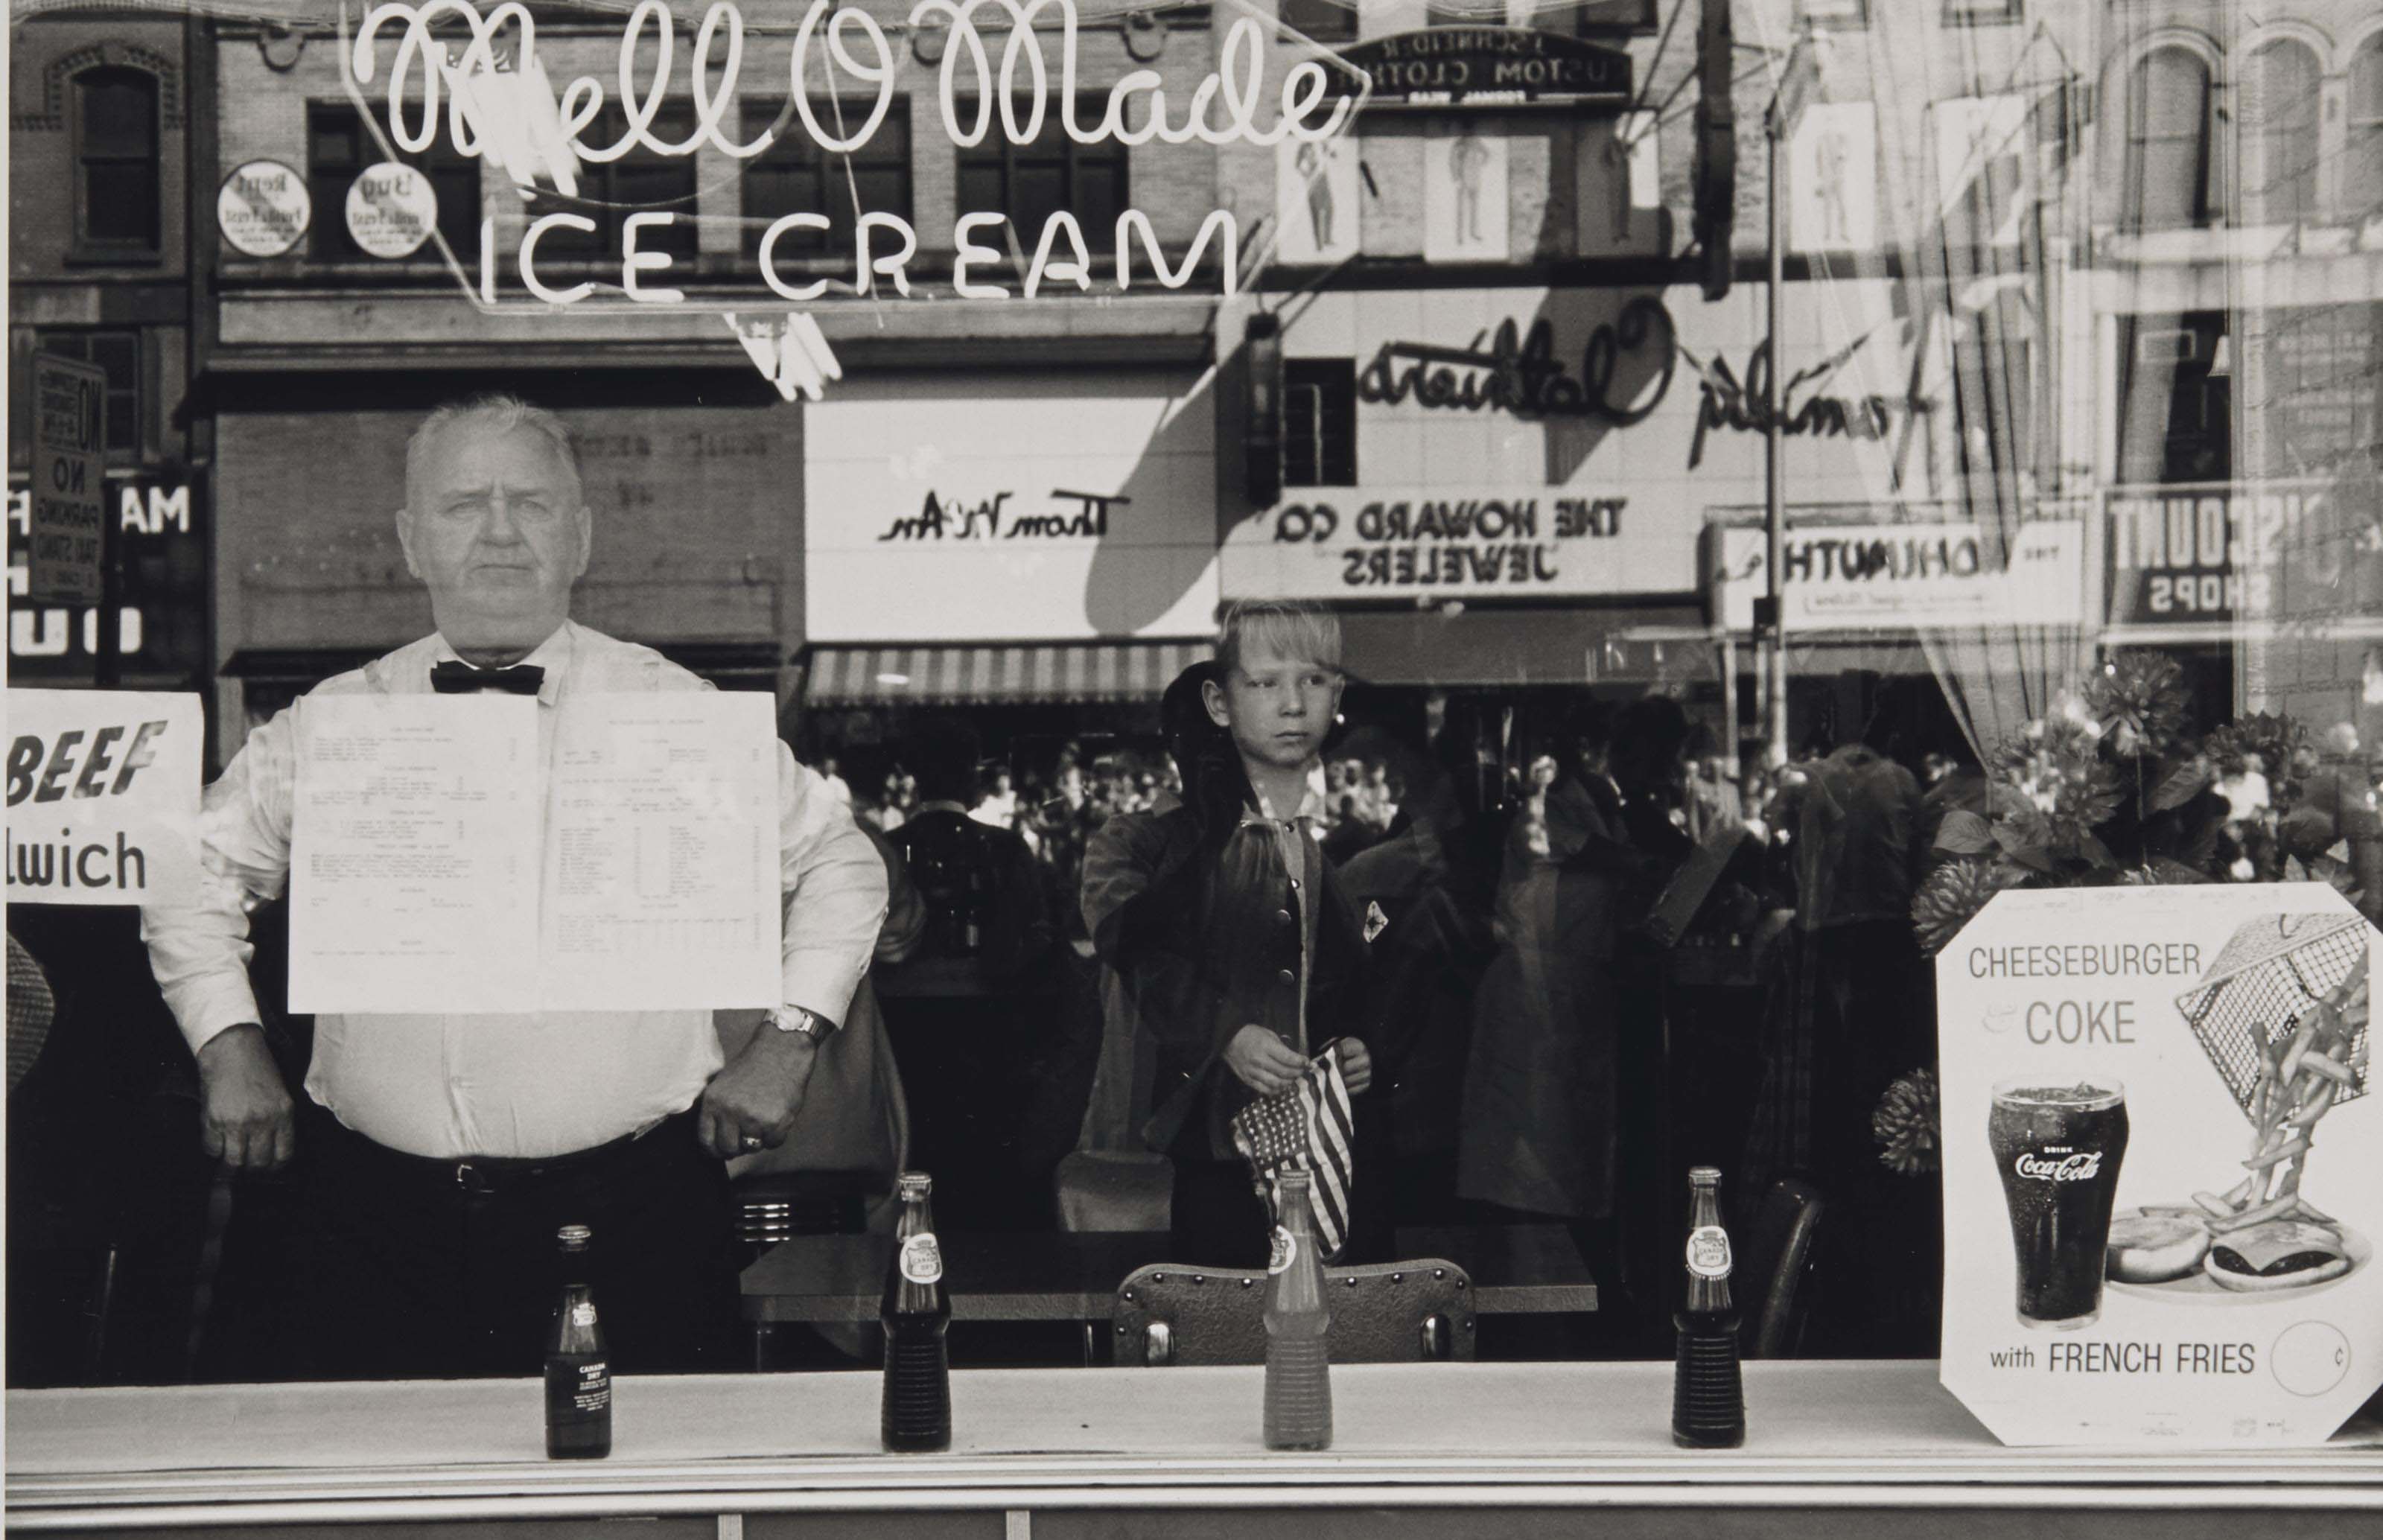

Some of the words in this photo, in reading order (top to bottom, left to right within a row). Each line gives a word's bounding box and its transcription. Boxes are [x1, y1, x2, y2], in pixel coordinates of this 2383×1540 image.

[792, 0, 894, 151] O
[910, 0, 1350, 145] Made
[480, 212, 684, 304] ICE
[759, 209, 1236, 300] CREAM
[7, 720, 168, 807] BEEF
[1969, 943, 2201, 978] CHEESEBURGER
[2026, 1000, 2136, 1044] COKE
[2015, 1151, 2103, 1181] Coca-Cola
[1991, 1344, 2034, 1369] with
[2049, 1342, 2160, 1373] FRENCH
[2177, 1343, 2256, 1374] FRIES
